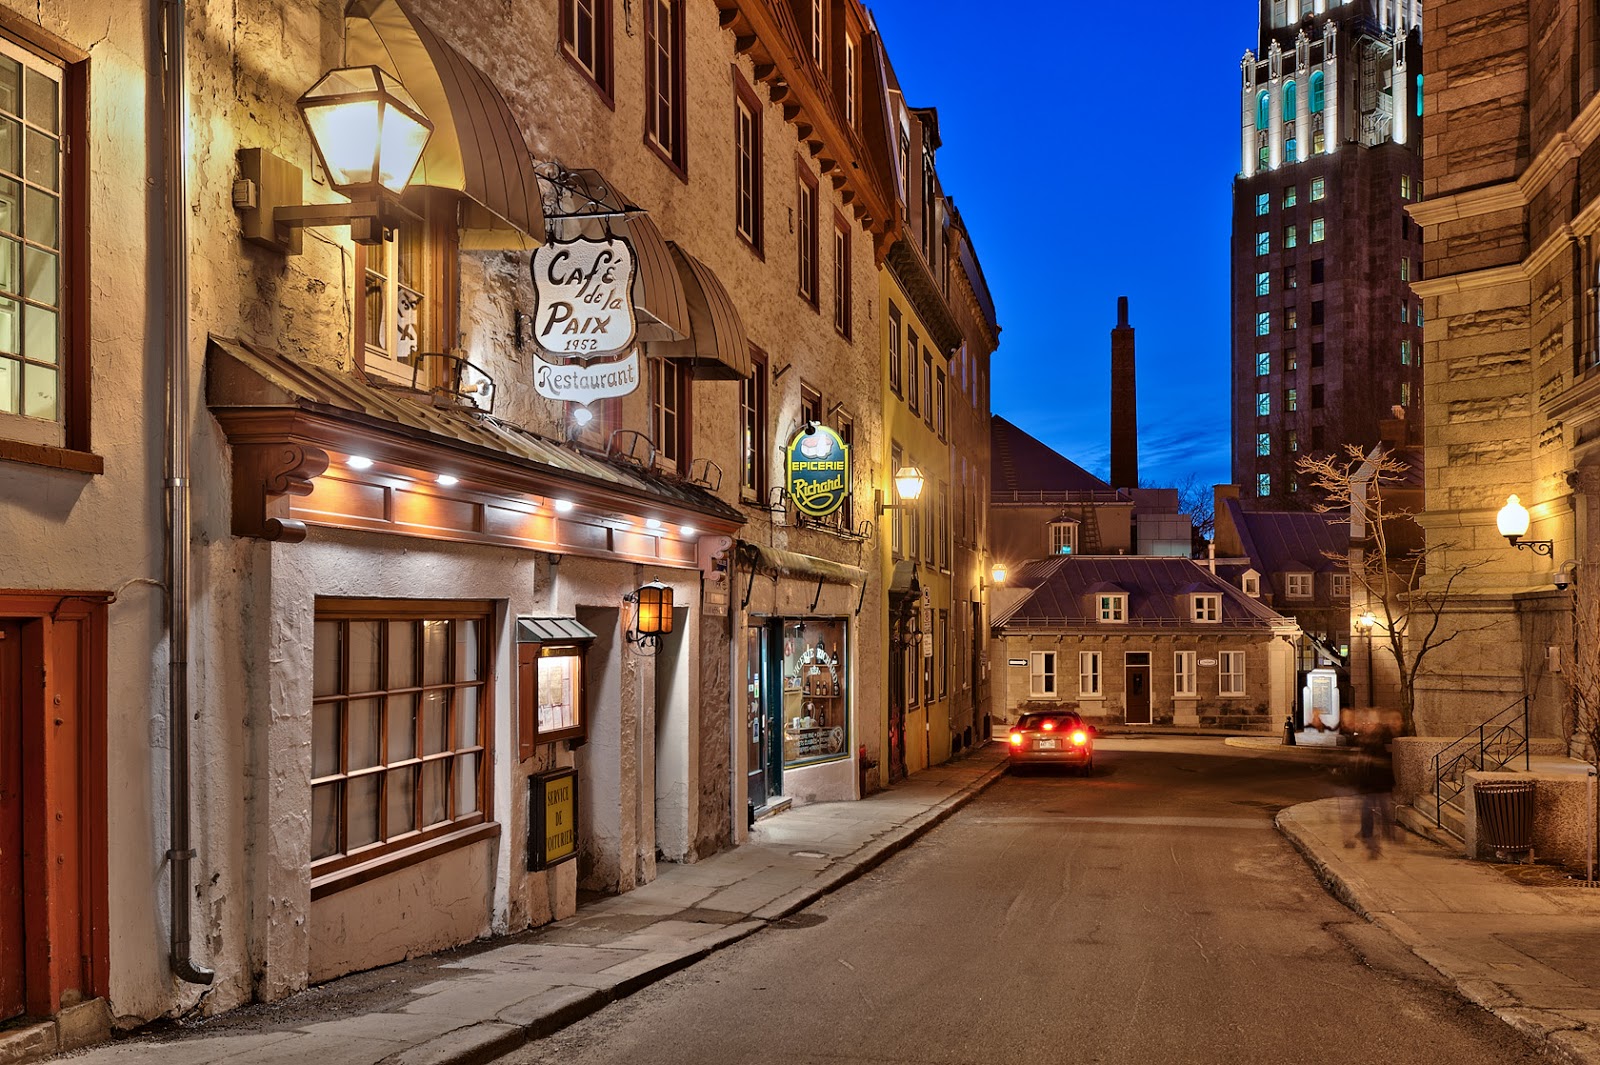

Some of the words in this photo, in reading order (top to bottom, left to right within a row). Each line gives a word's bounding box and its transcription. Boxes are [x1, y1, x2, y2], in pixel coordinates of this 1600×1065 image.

[600, 288, 624, 311] la
[564, 339, 598, 351] 1952
[537, 364, 634, 396] Restaurant
[791, 461, 845, 471] EPICERIE
[793, 473, 844, 508] Richard
[547, 786, 569, 806] SERVICE
[555, 810, 563, 827] DE
[546, 829, 573, 851] OITURIER
